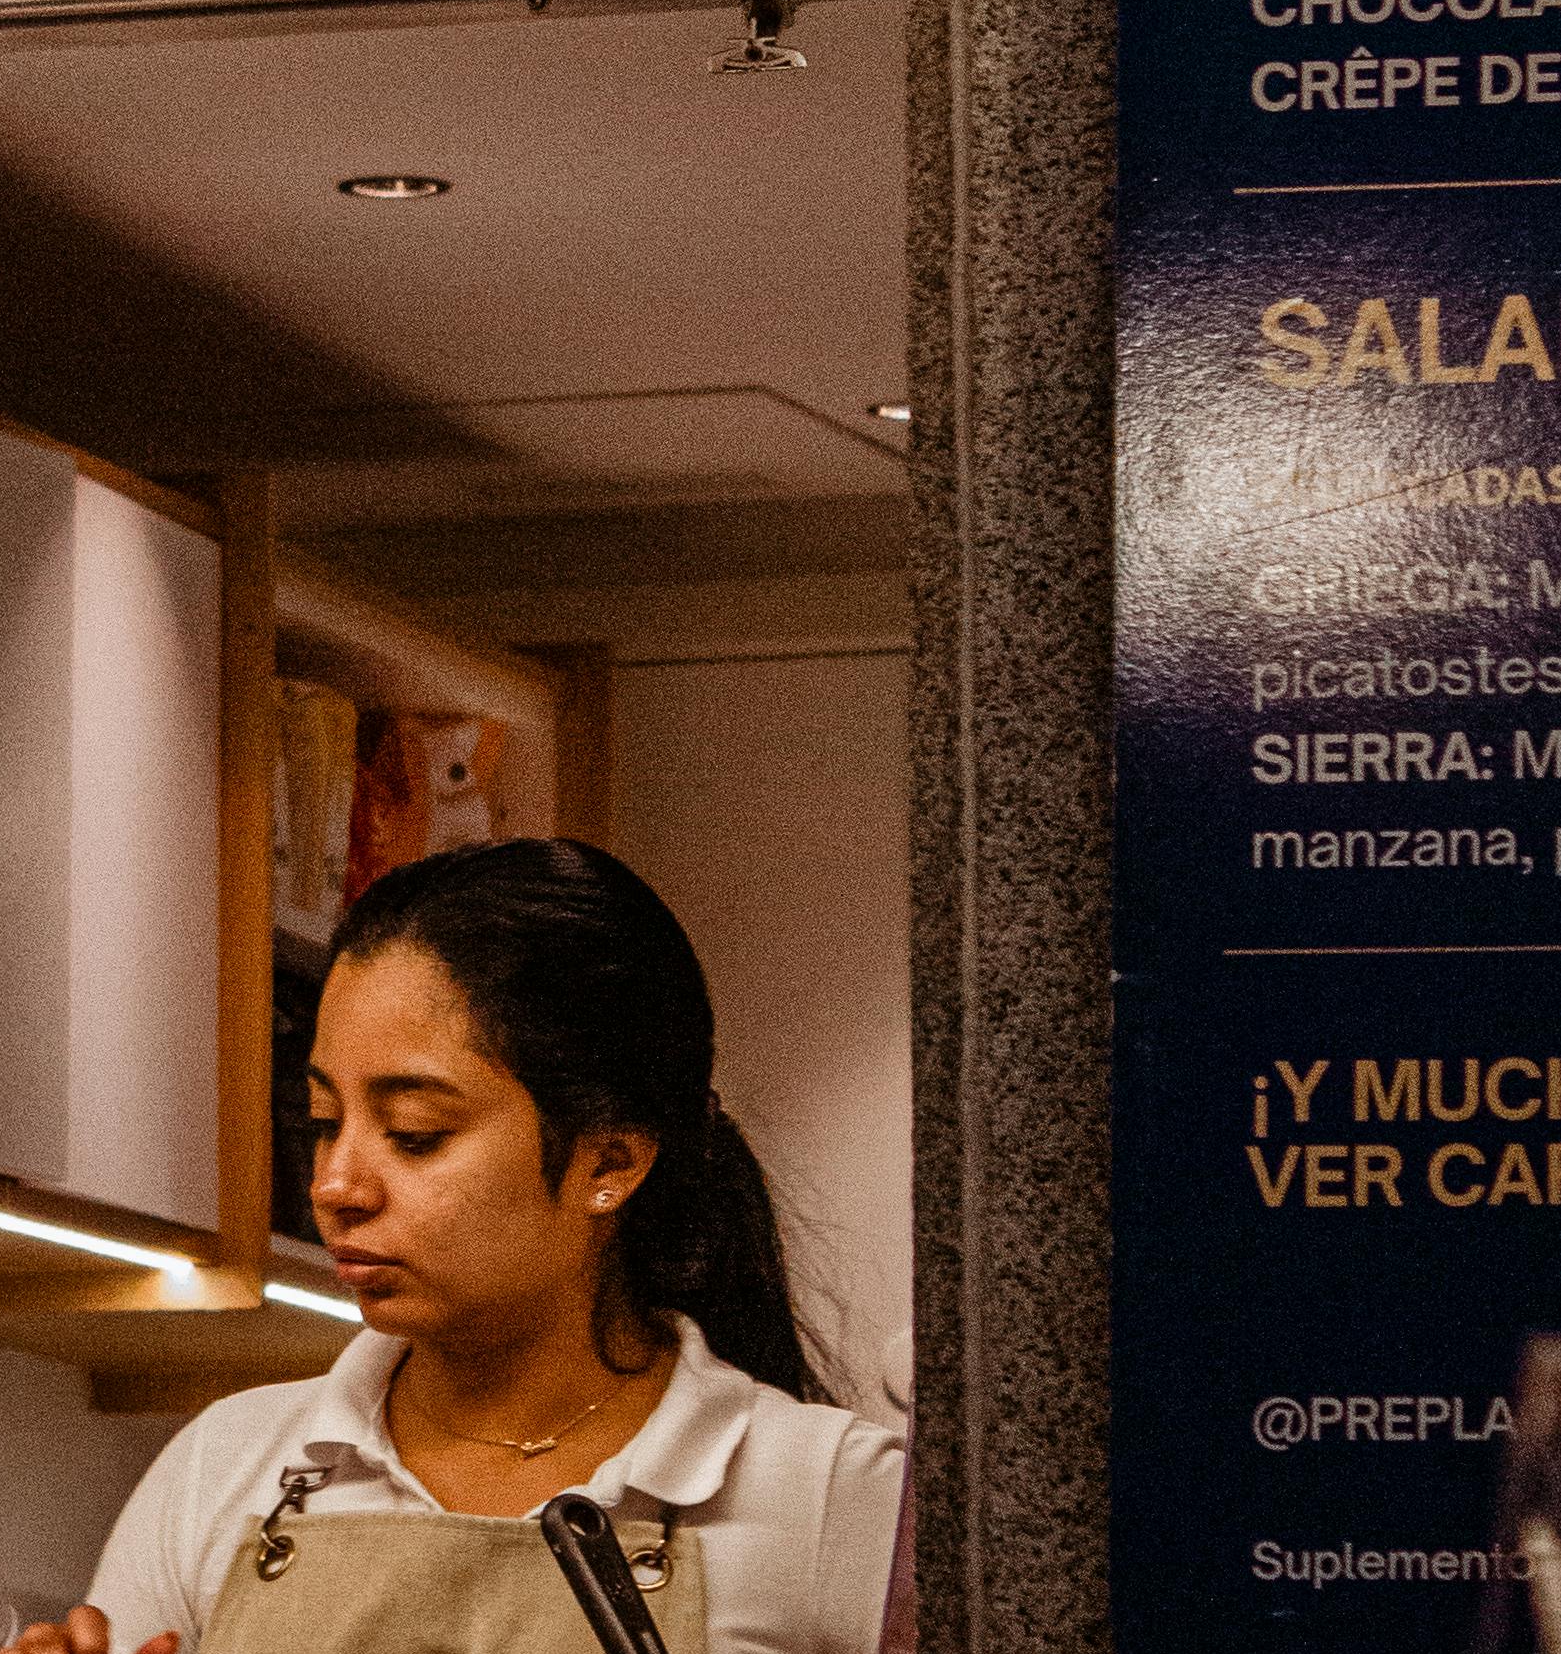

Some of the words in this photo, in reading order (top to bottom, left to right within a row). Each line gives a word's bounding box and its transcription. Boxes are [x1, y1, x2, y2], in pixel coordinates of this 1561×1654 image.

[1251, 46, 1460, 113] CRÊPE
[1479, 52, 1561, 105] DE
[1260, 294, 1557, 389] SALA
[1251, 649, 1561, 712] picatostes
[1251, 731, 1494, 785] SIERRA:
[1513, 728, 1561, 779] M
[1252, 827, 1534, 875] manzana,
[1253, 1059, 1330, 1138] ¡Y
[1353, 1056, 1561, 1122] MUC
[1245, 1144, 1403, 1208] VER
[1427, 1142, 1561, 1207] CA
